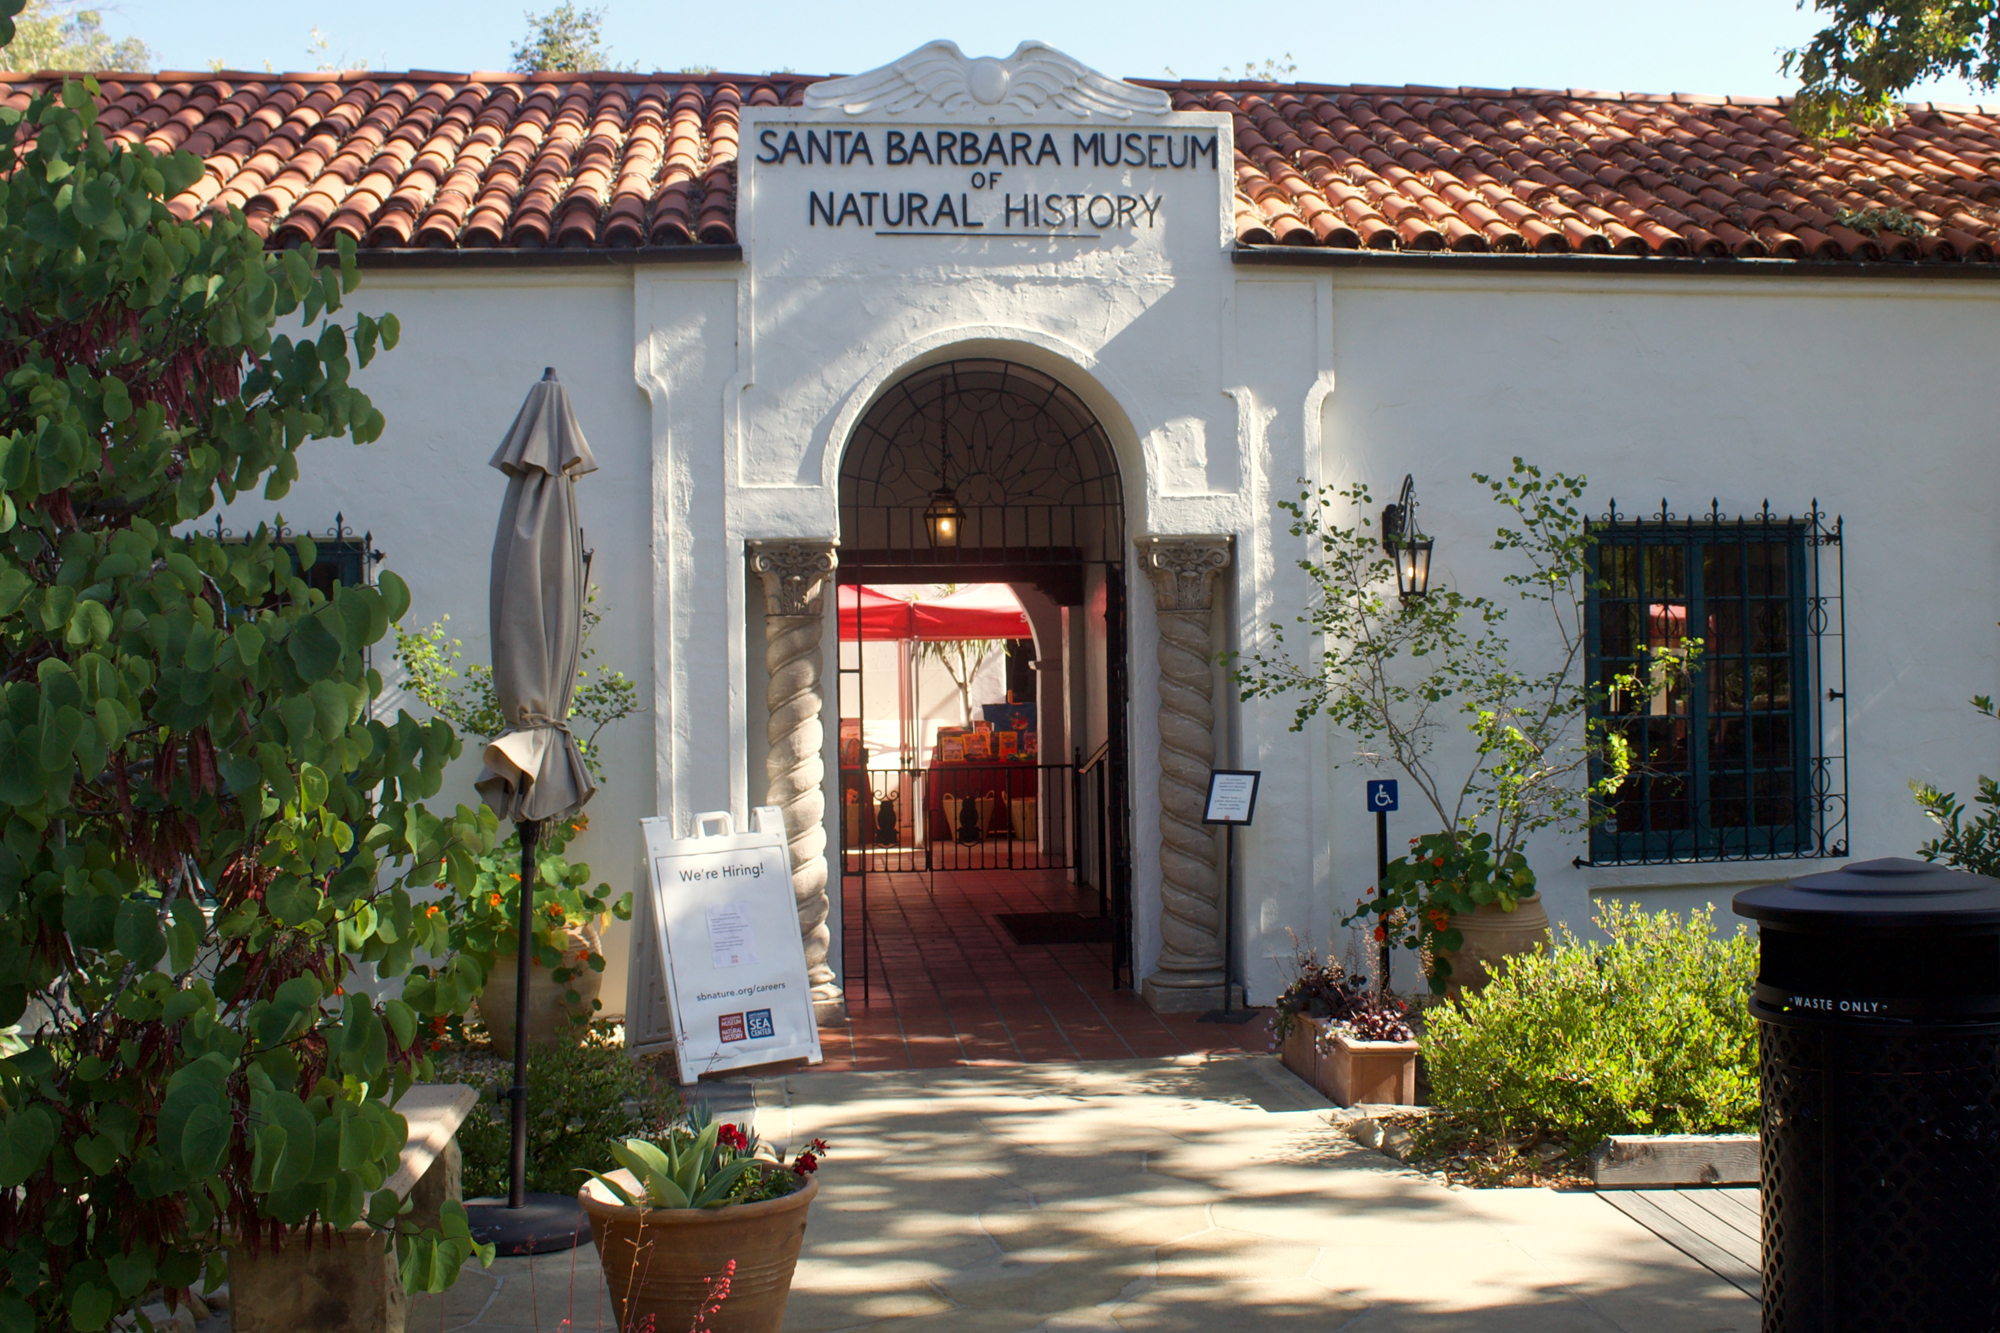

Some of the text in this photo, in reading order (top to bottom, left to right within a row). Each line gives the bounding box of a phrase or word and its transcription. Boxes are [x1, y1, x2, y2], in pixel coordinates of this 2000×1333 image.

[756, 129, 1218, 170] SANTA BARBARA MUSEUM
[971, 171, 1002, 190] OF
[809, 191, 1163, 229] NATURAL HISTORY
[679, 862, 764, 882] We're Hiring!
[696, 981, 786, 1002] sbnature.org/careers
[1794, 996, 1879, 1012] WASTE ONLY
[749, 1018, 771, 1030] SEA
[750, 1027, 773, 1037] CENTER
